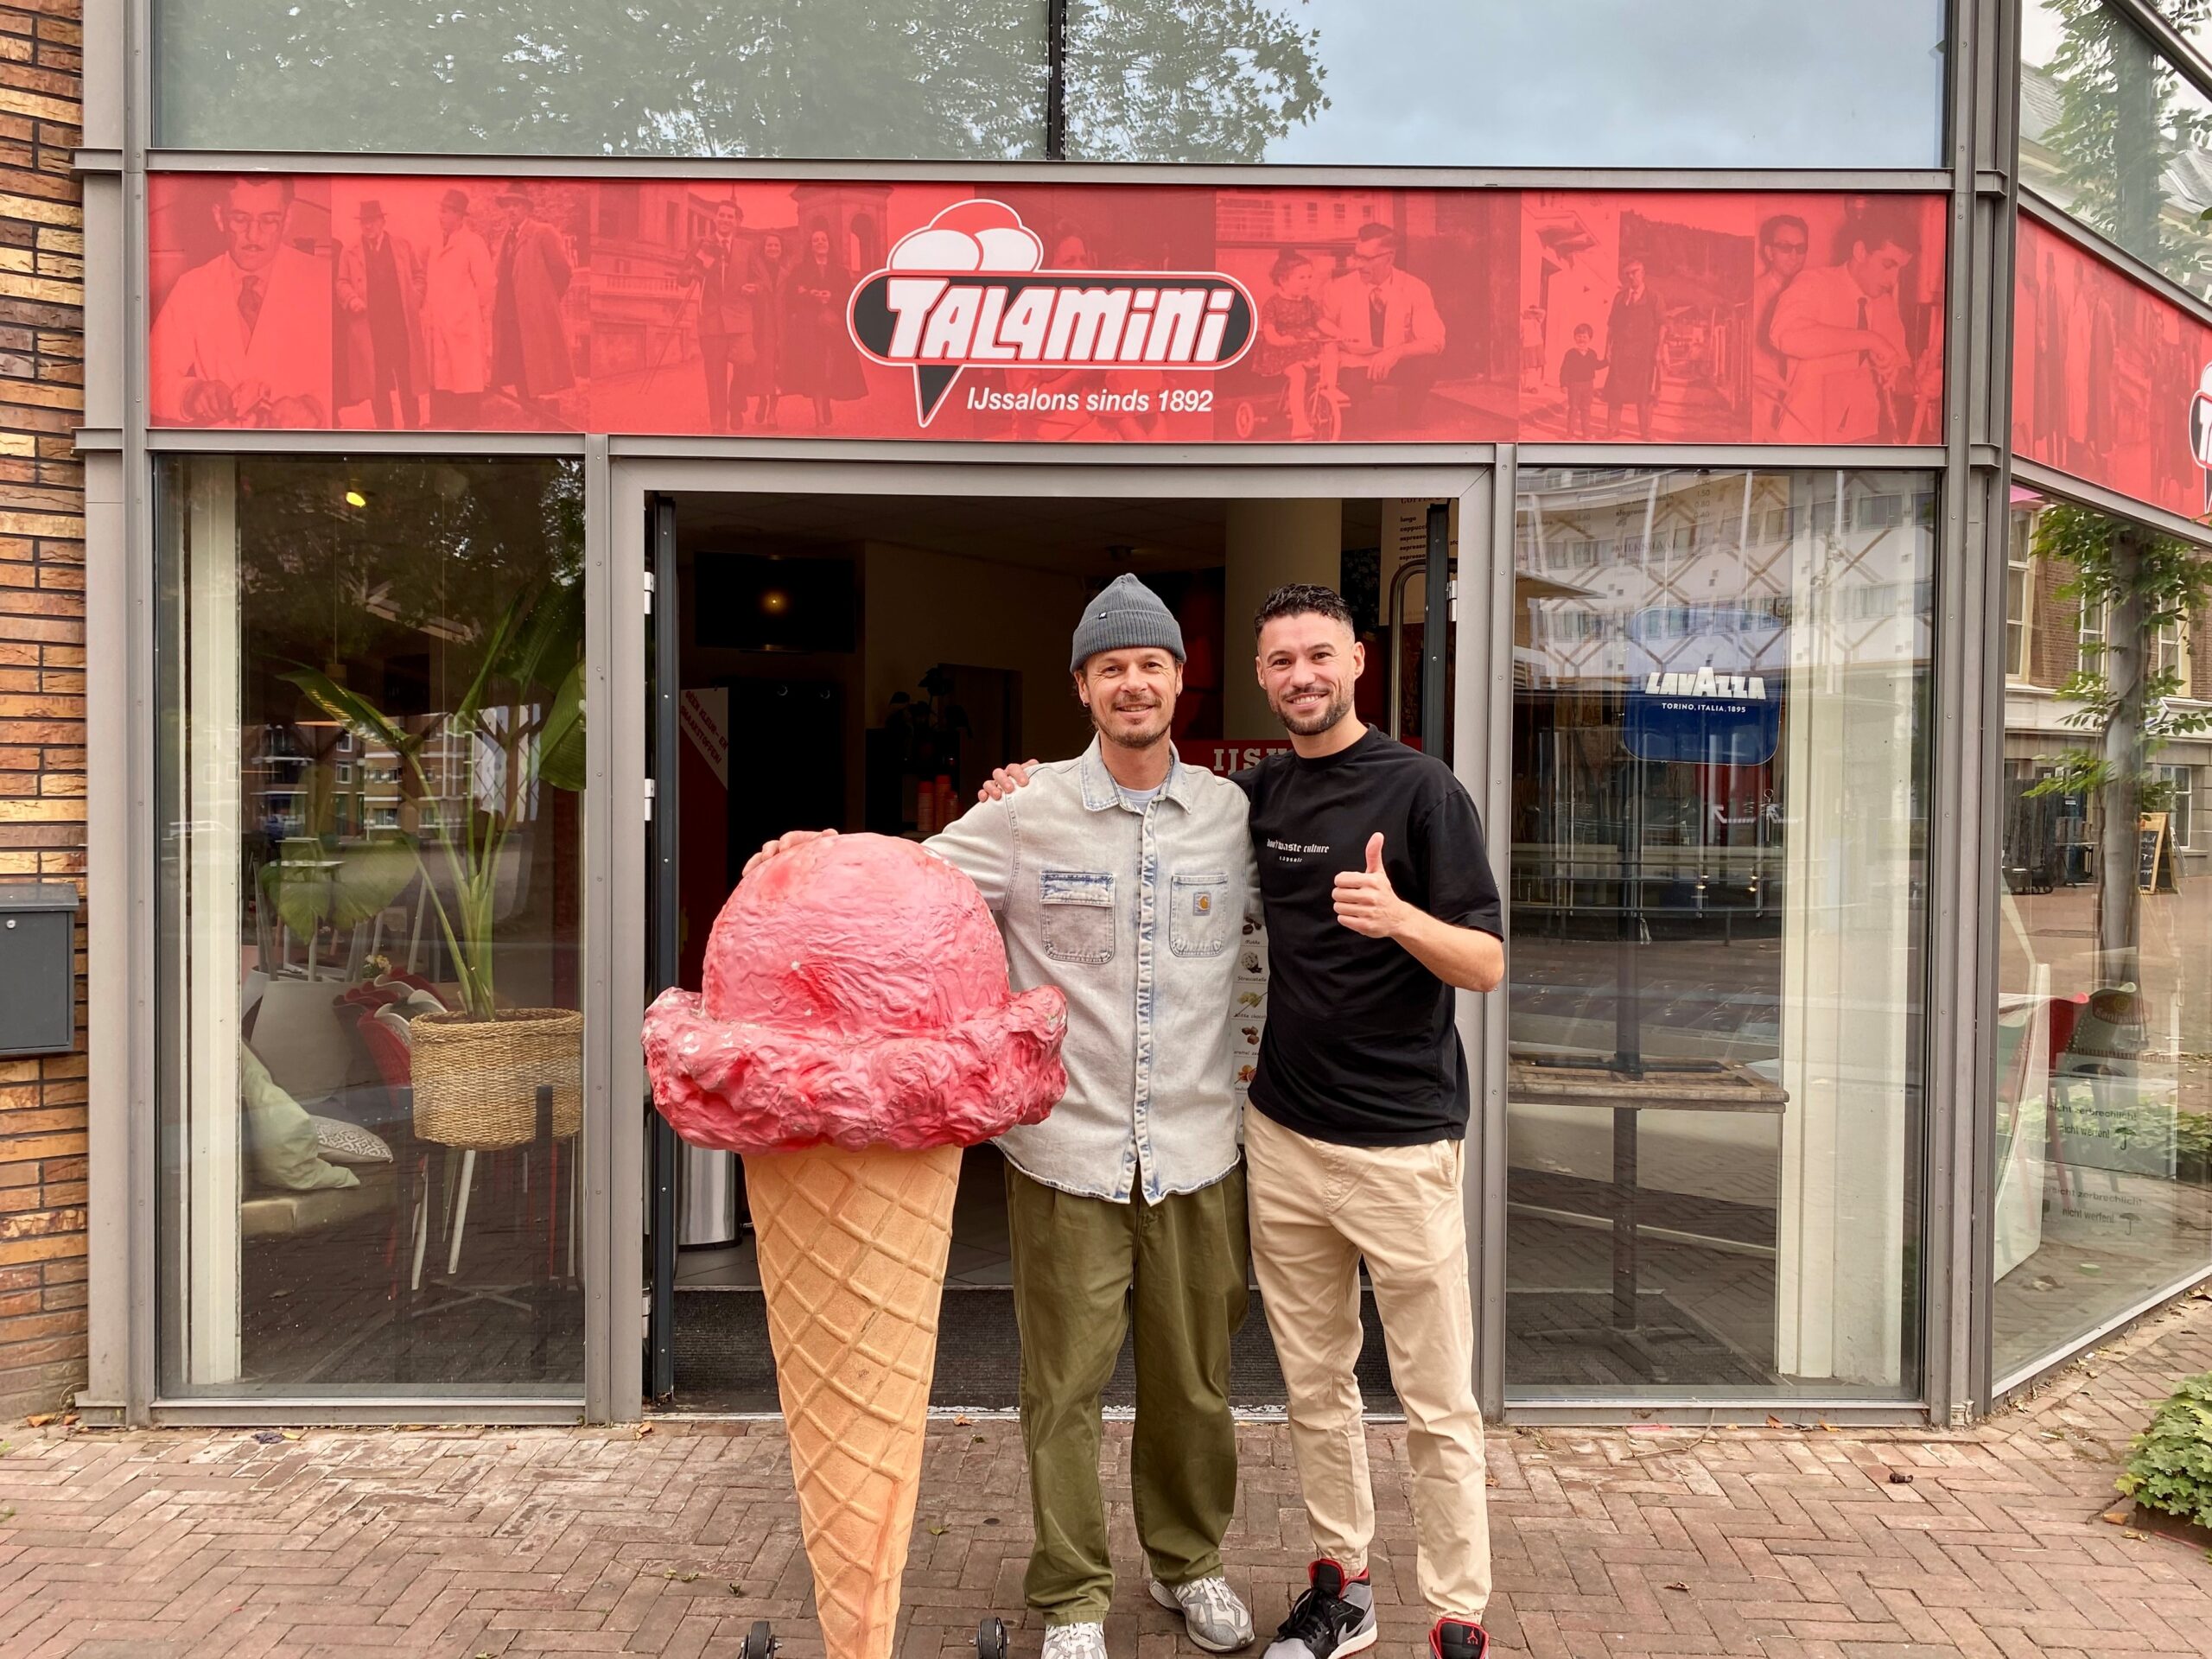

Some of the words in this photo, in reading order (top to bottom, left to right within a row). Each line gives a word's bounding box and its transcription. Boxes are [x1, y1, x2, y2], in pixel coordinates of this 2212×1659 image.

[967, 386, 1079, 412] IJssalons
[1085, 388, 1149, 413] sinds
[1158, 389, 1213, 413] 1892
[1645, 666, 1766, 699] LAVAZZA
[1213, 747, 1288, 778] IJS
[1303, 843, 1330, 854] culture
[2063, 1208, 2082, 1218] nicht
